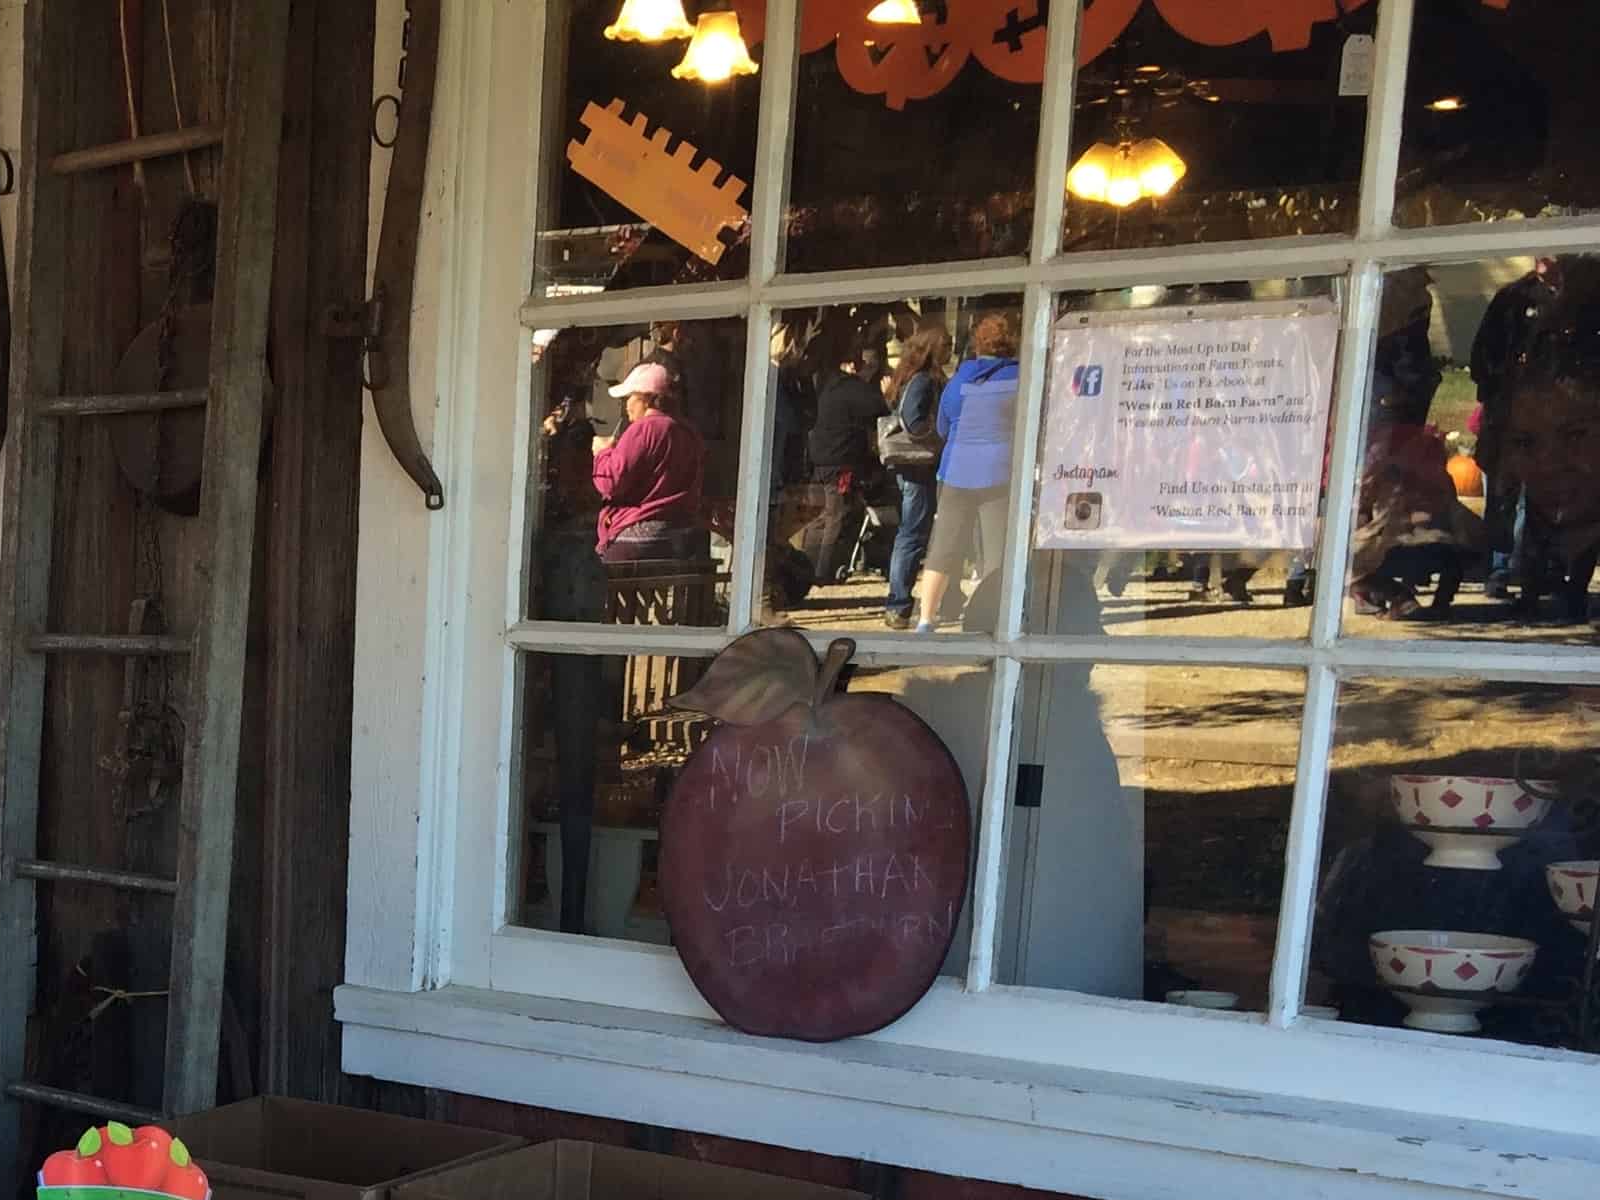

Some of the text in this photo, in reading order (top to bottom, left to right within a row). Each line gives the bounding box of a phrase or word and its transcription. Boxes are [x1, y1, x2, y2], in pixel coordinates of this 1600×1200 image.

[1124, 346, 1144, 358] For
[1167, 343, 1194, 356] Most
[1175, 396, 1201, 409] Red
[1053, 463, 1120, 488] Instagram
[1159, 481, 1188, 495] Find
[709, 733, 809, 808] NOW
